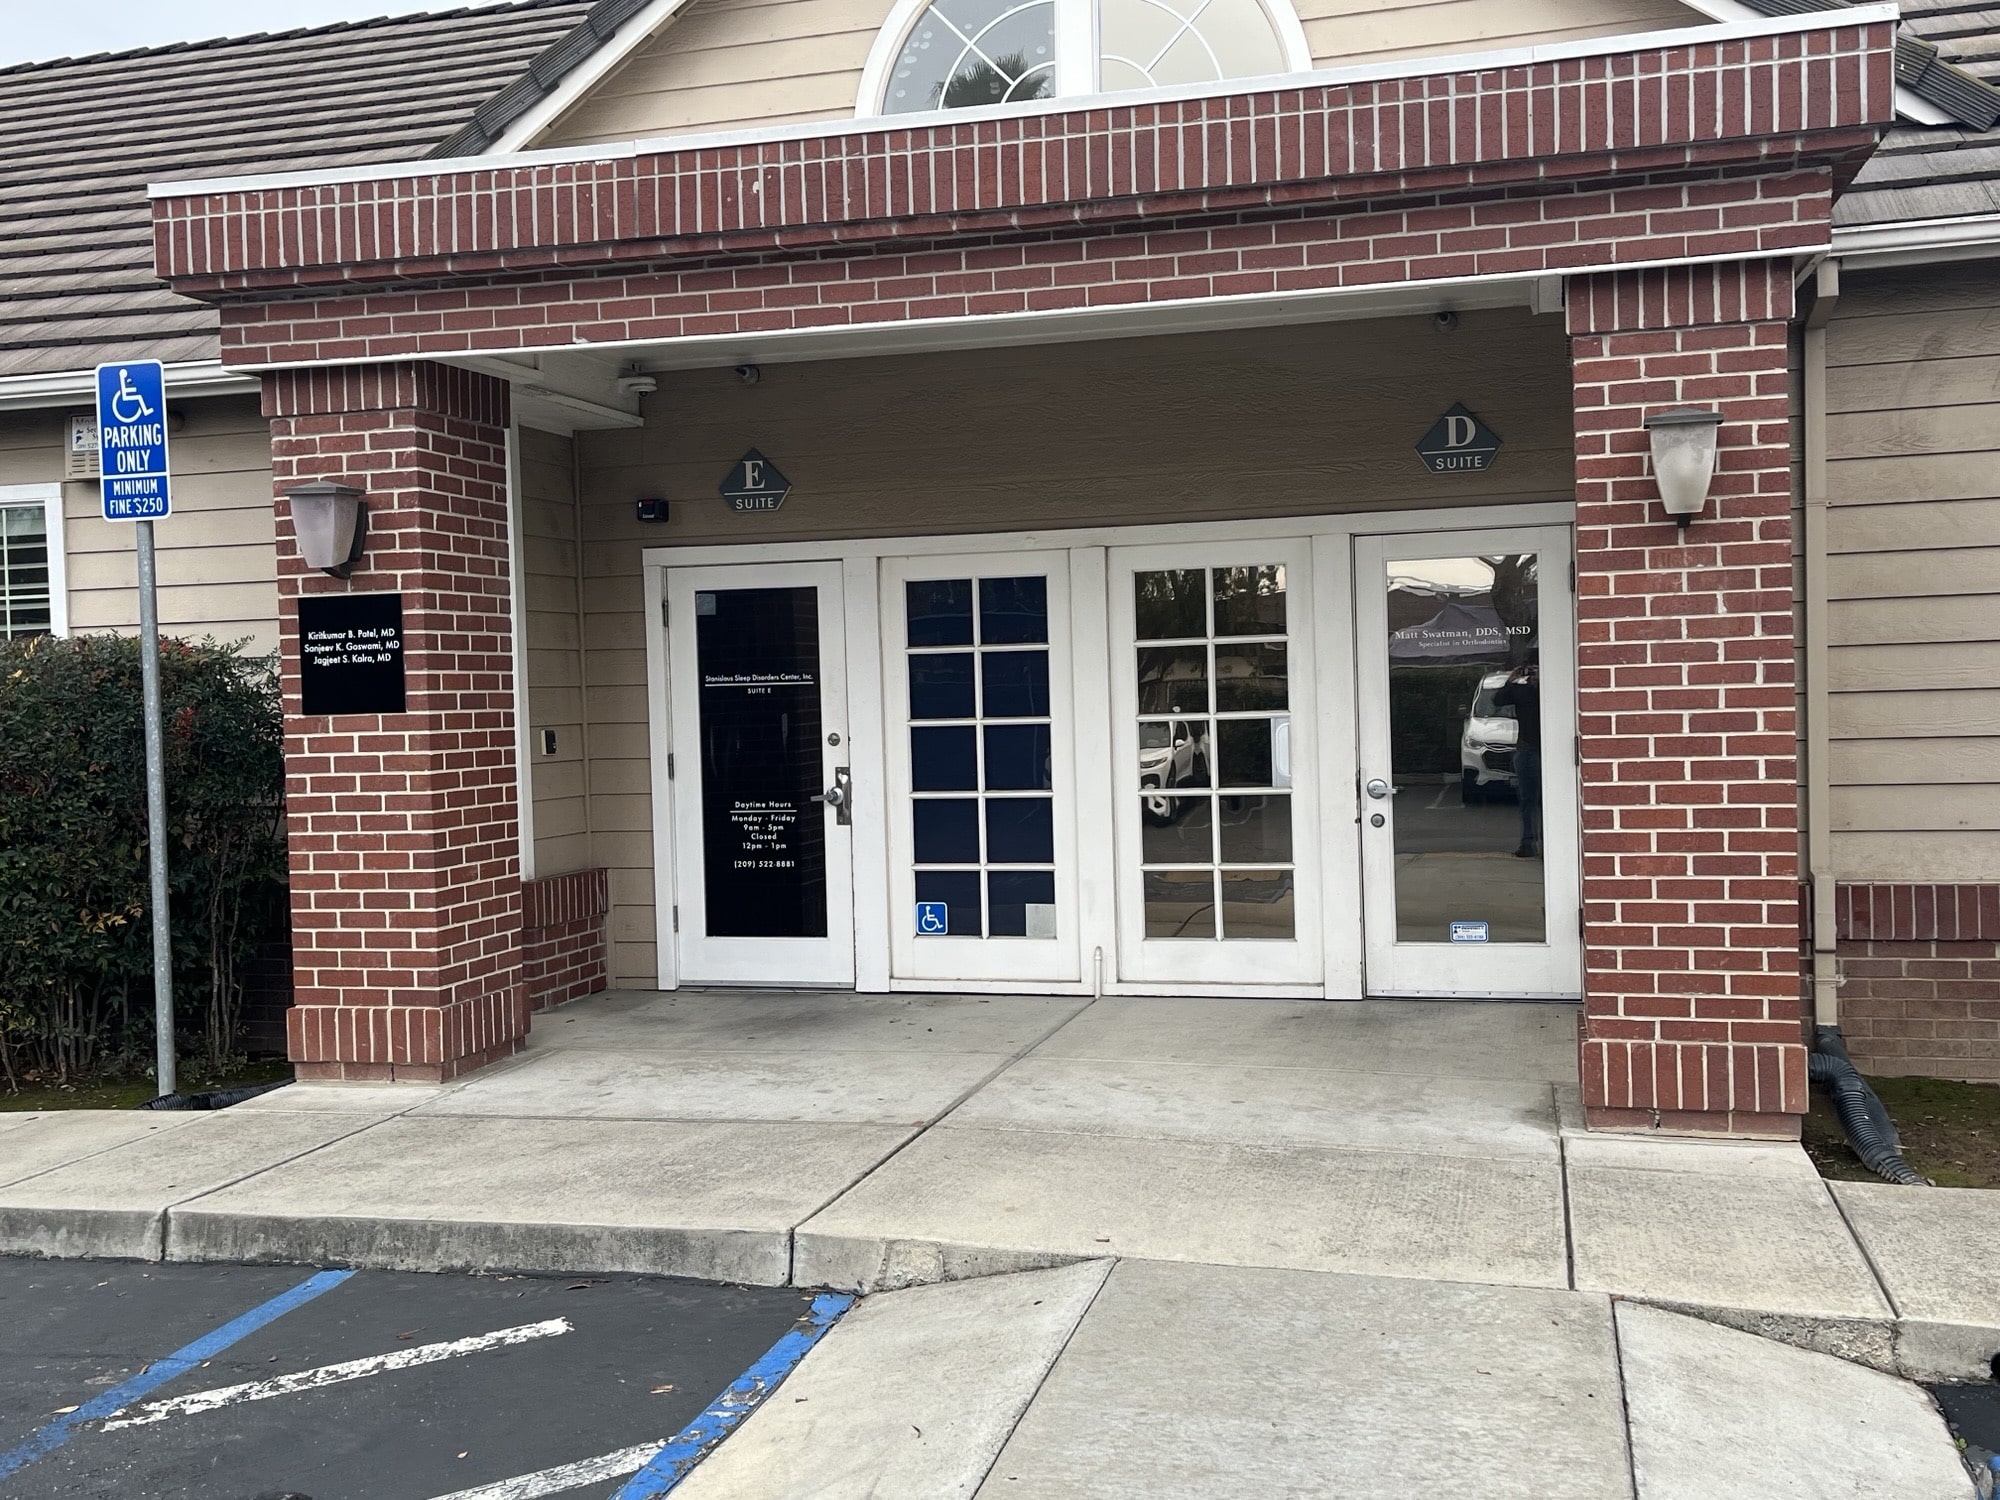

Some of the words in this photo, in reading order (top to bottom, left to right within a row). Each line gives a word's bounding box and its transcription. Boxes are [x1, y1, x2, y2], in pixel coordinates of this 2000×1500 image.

[104, 423, 162, 448] PARKING
[1444, 415, 1476, 448] D
[116, 449, 150, 472] ONLY
[1435, 455, 1482, 470] SUITE
[742, 460, 765, 489] E
[113, 478, 158, 496] MINIMUM
[110, 498, 132, 515] FINE
[132, 497, 163, 515] $250
[735, 497, 775, 510] SUITE
[347, 629, 356, 639] B.
[357, 628, 379, 639] Patel,
[380, 628, 395, 637] MD
[1395, 631, 1418, 640] Matt
[1422, 630, 1472, 639] Swatman,
[1476, 627, 1501, 637] DDS,
[1505, 625, 1531, 635] MSD
[304, 643, 334, 654] Sanjeev
[335, 642, 344, 651] K.
[345, 640, 383, 651] Goswami,
[385, 640, 400, 649] MD
[1419, 640, 1450, 648] Specialist
[1462, 638, 1507, 646] Orthodontics
[342, 654, 350, 664] S.
[352, 653, 375, 664] Kalra,
[377, 653, 392, 662] MD
[705, 674, 734, 682] Stanislaus
[734, 674, 751, 683] Sleep
[752, 673, 780, 681] Disorders
[780, 673, 802, 681] Center,
[802, 672, 814, 680] Inc.
[735, 801, 766, 810] Daytime
[731, 814, 763, 823] Monday
[770, 813, 796, 823] Friday
[743, 823, 760, 831] 9am
[767, 823, 784, 832] 5pm
[750, 832, 777, 840] Closed
[742, 842, 763, 851] 12pm
[771, 841, 787, 850] 1pm
[734, 860, 756, 869] (209)
